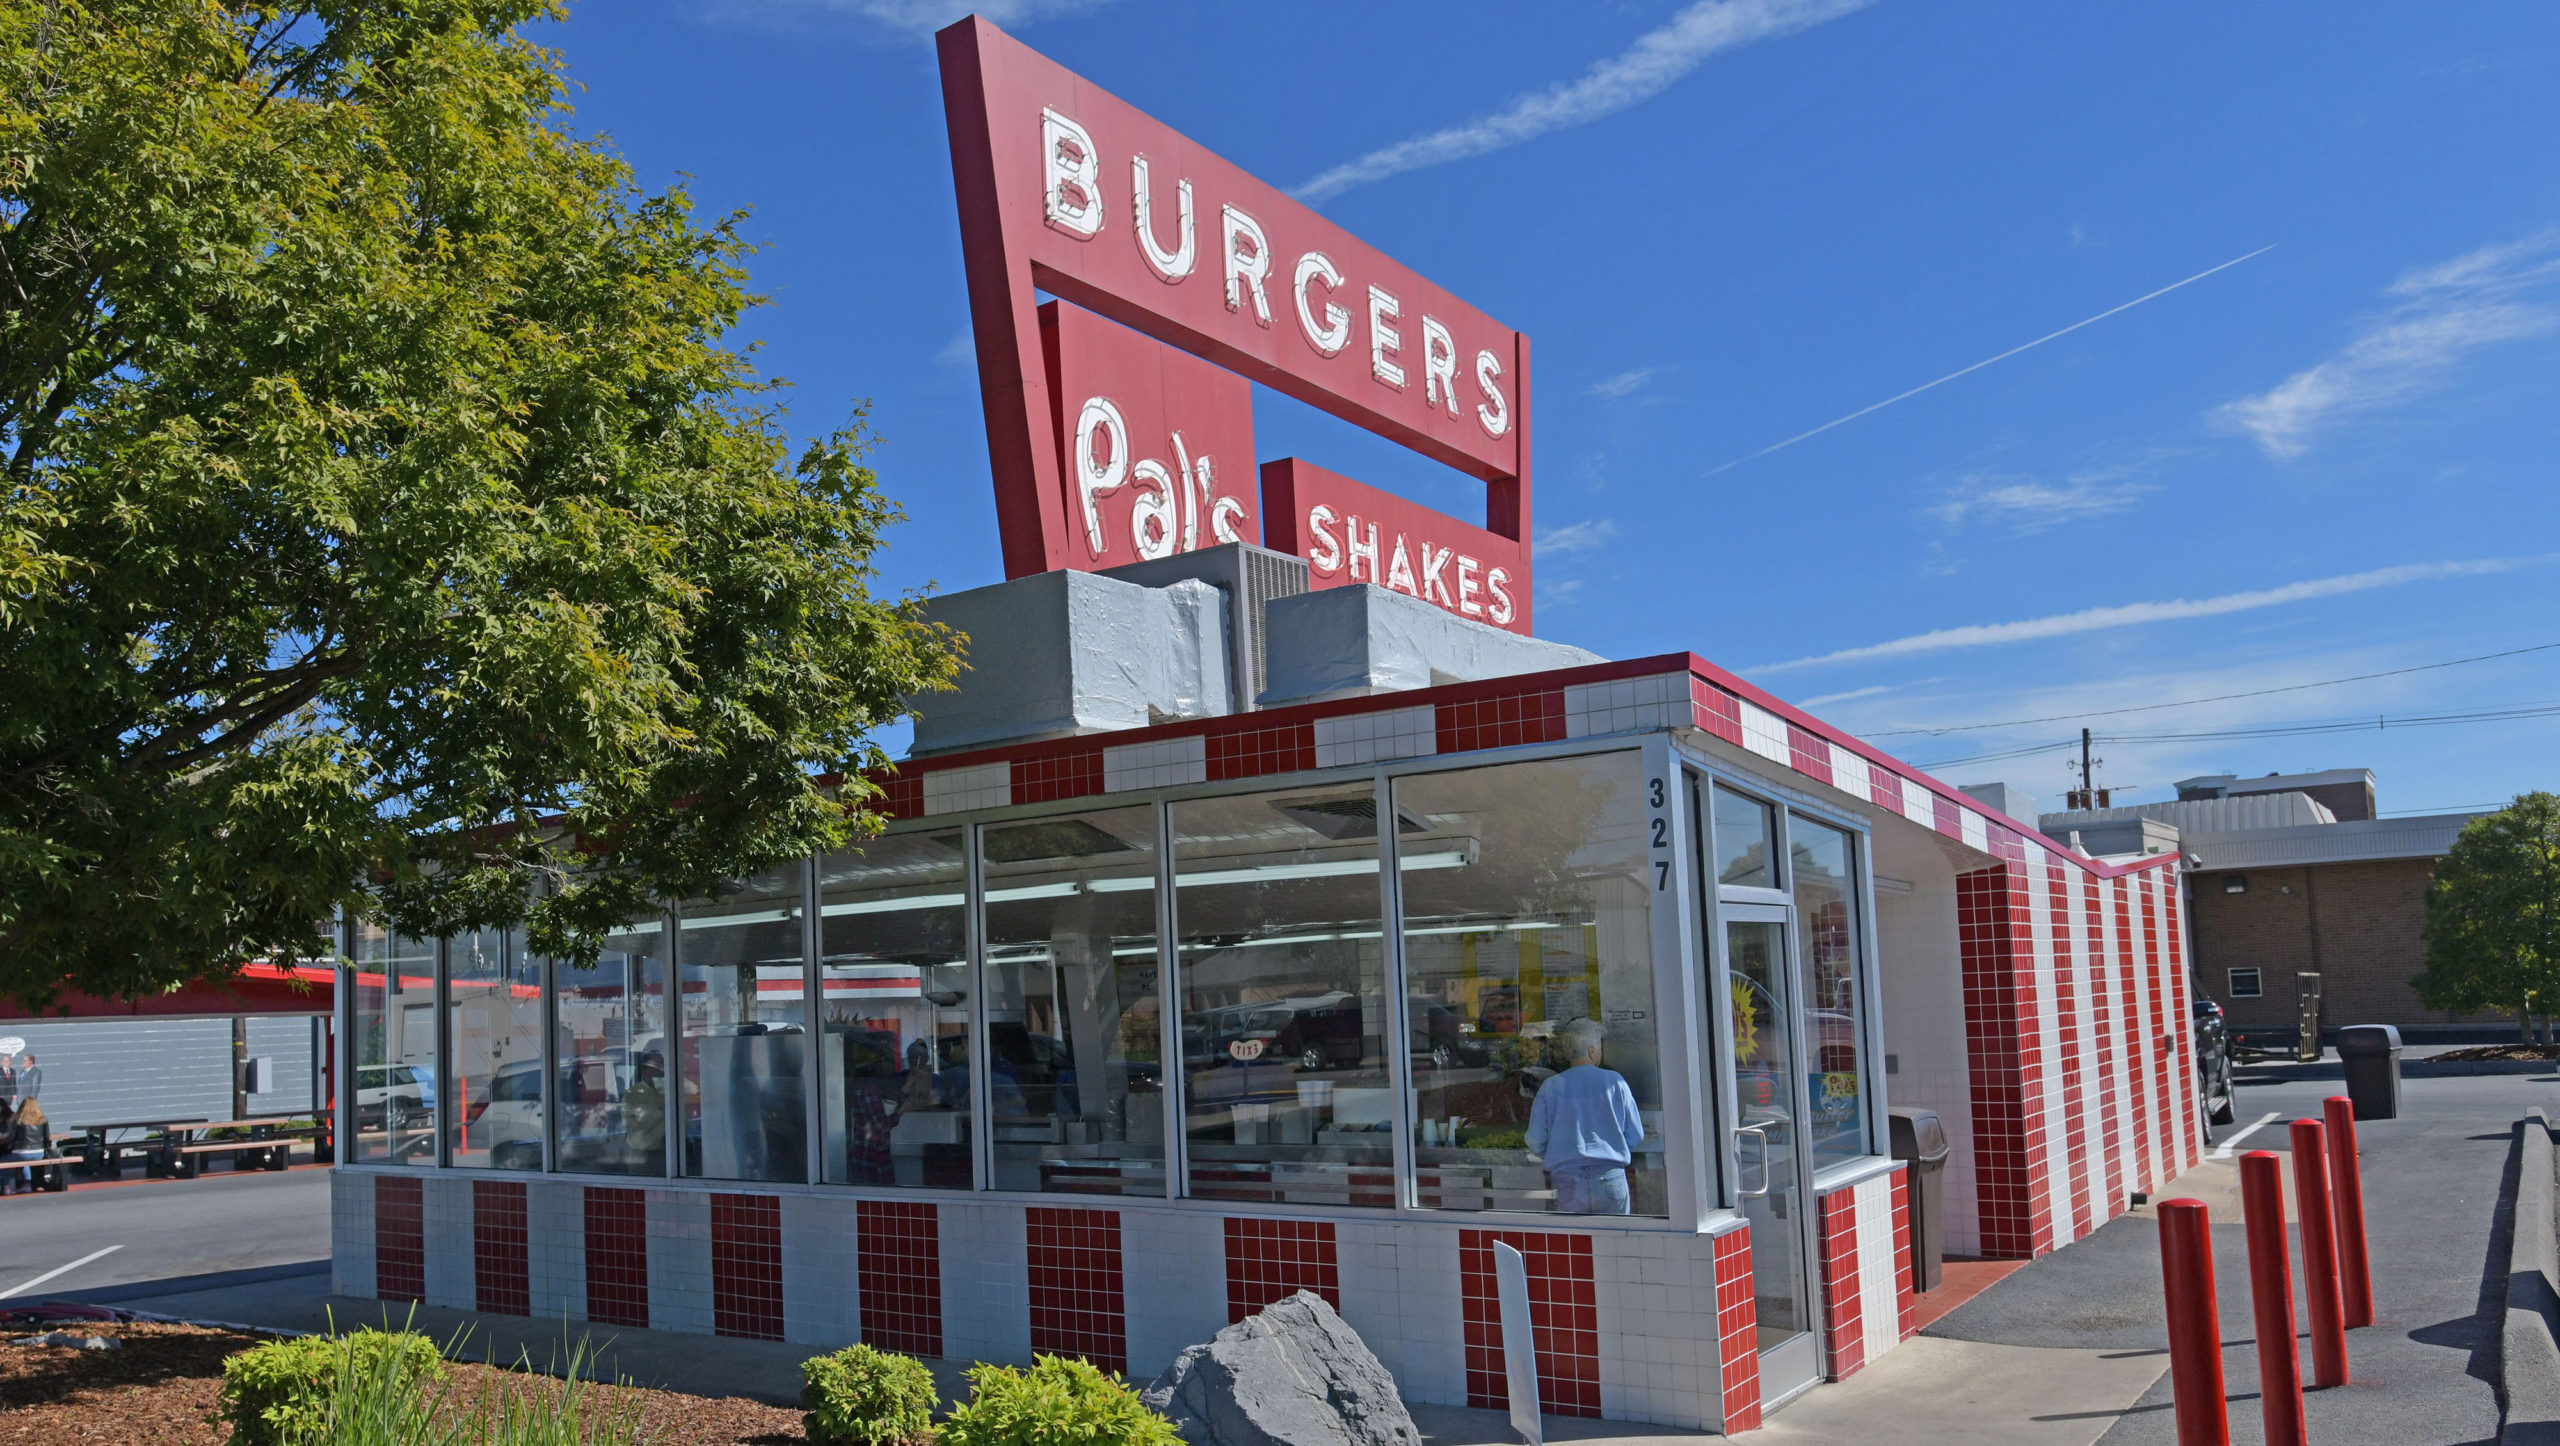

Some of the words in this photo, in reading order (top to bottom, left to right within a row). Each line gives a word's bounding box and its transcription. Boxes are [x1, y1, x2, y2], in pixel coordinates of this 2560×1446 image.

[1041, 104, 1511, 436] BURGERS
[1076, 396, 1246, 561] Pal's
[1309, 504, 1516, 625] SHAKES
